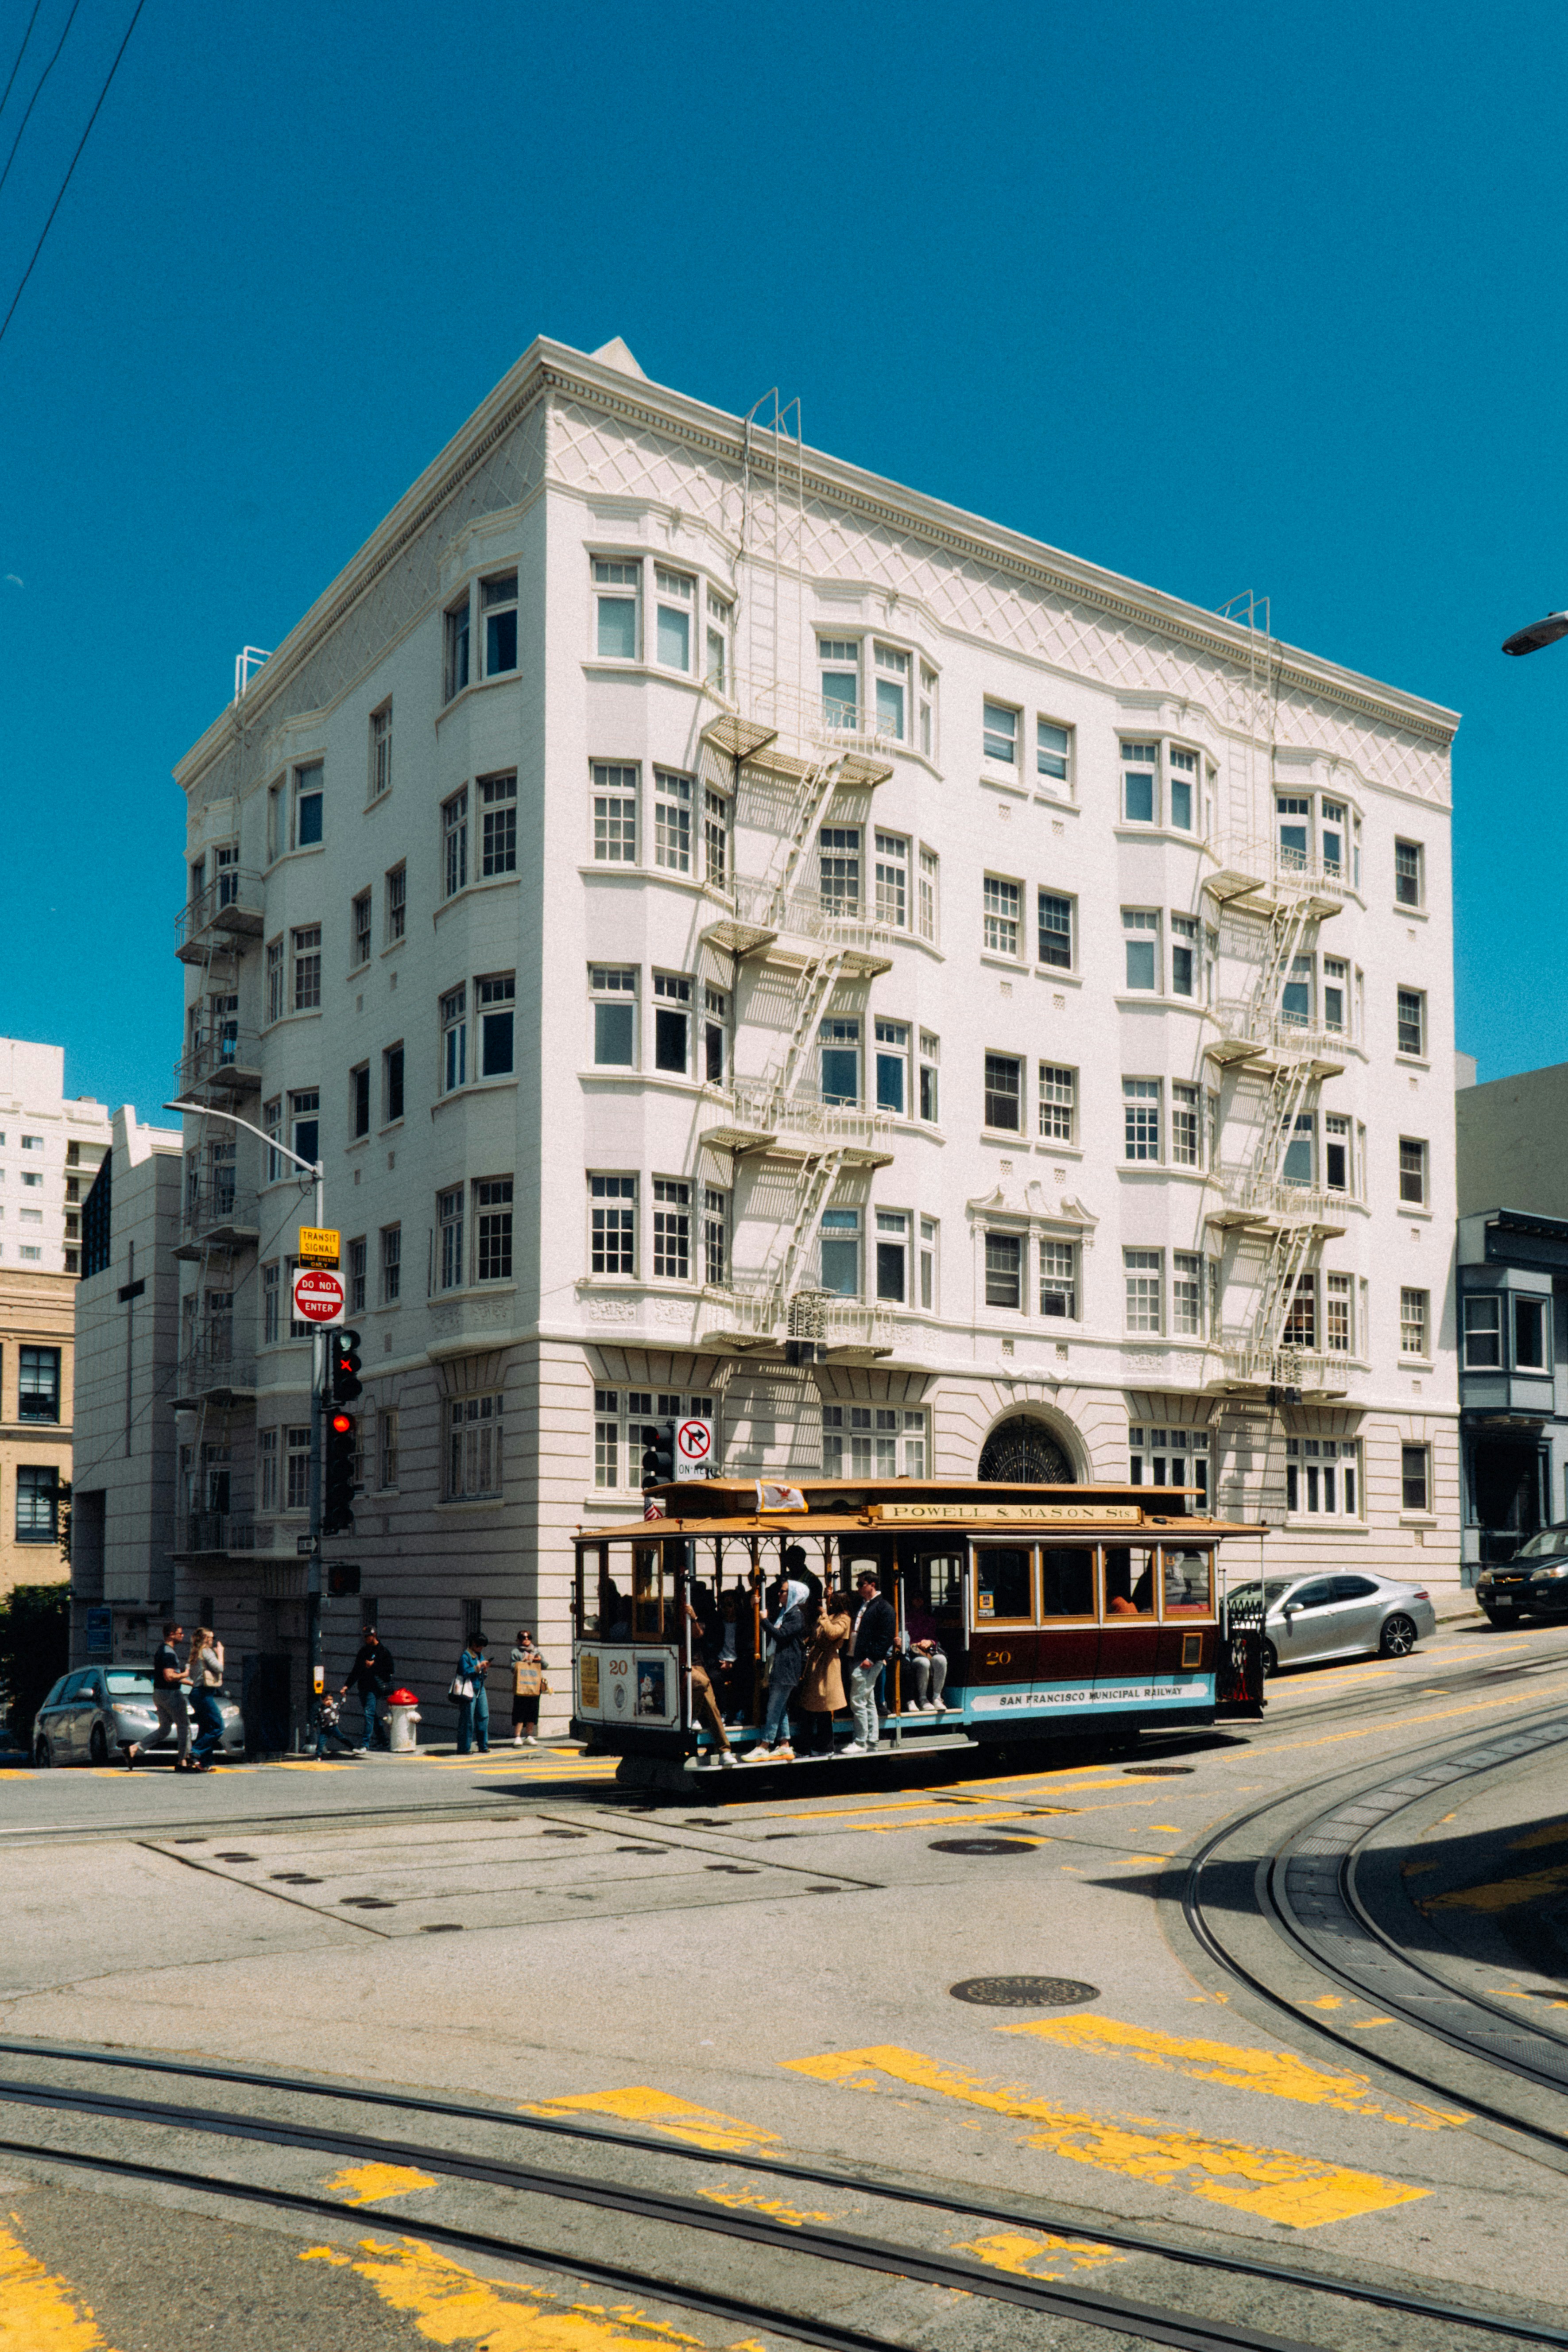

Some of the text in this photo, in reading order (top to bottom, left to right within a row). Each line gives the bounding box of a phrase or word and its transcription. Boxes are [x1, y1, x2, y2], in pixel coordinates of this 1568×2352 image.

[303, 1231, 337, 1242] TRANSIT
[305, 1243, 334, 1254] SIGNAL
[302, 1279, 337, 1290] DO NOT
[305, 1302, 333, 1312] ENTER
[679, 1464, 690, 1474] ON
[893, 1507, 1133, 1518] POWELL & MASON Sts.
[986, 1651, 1011, 1665] 20
[609, 1660, 628, 1675] 20
[1000, 1687, 1182, 1705] SAN FRANCISCO MUNICIPAL RAILWAY
